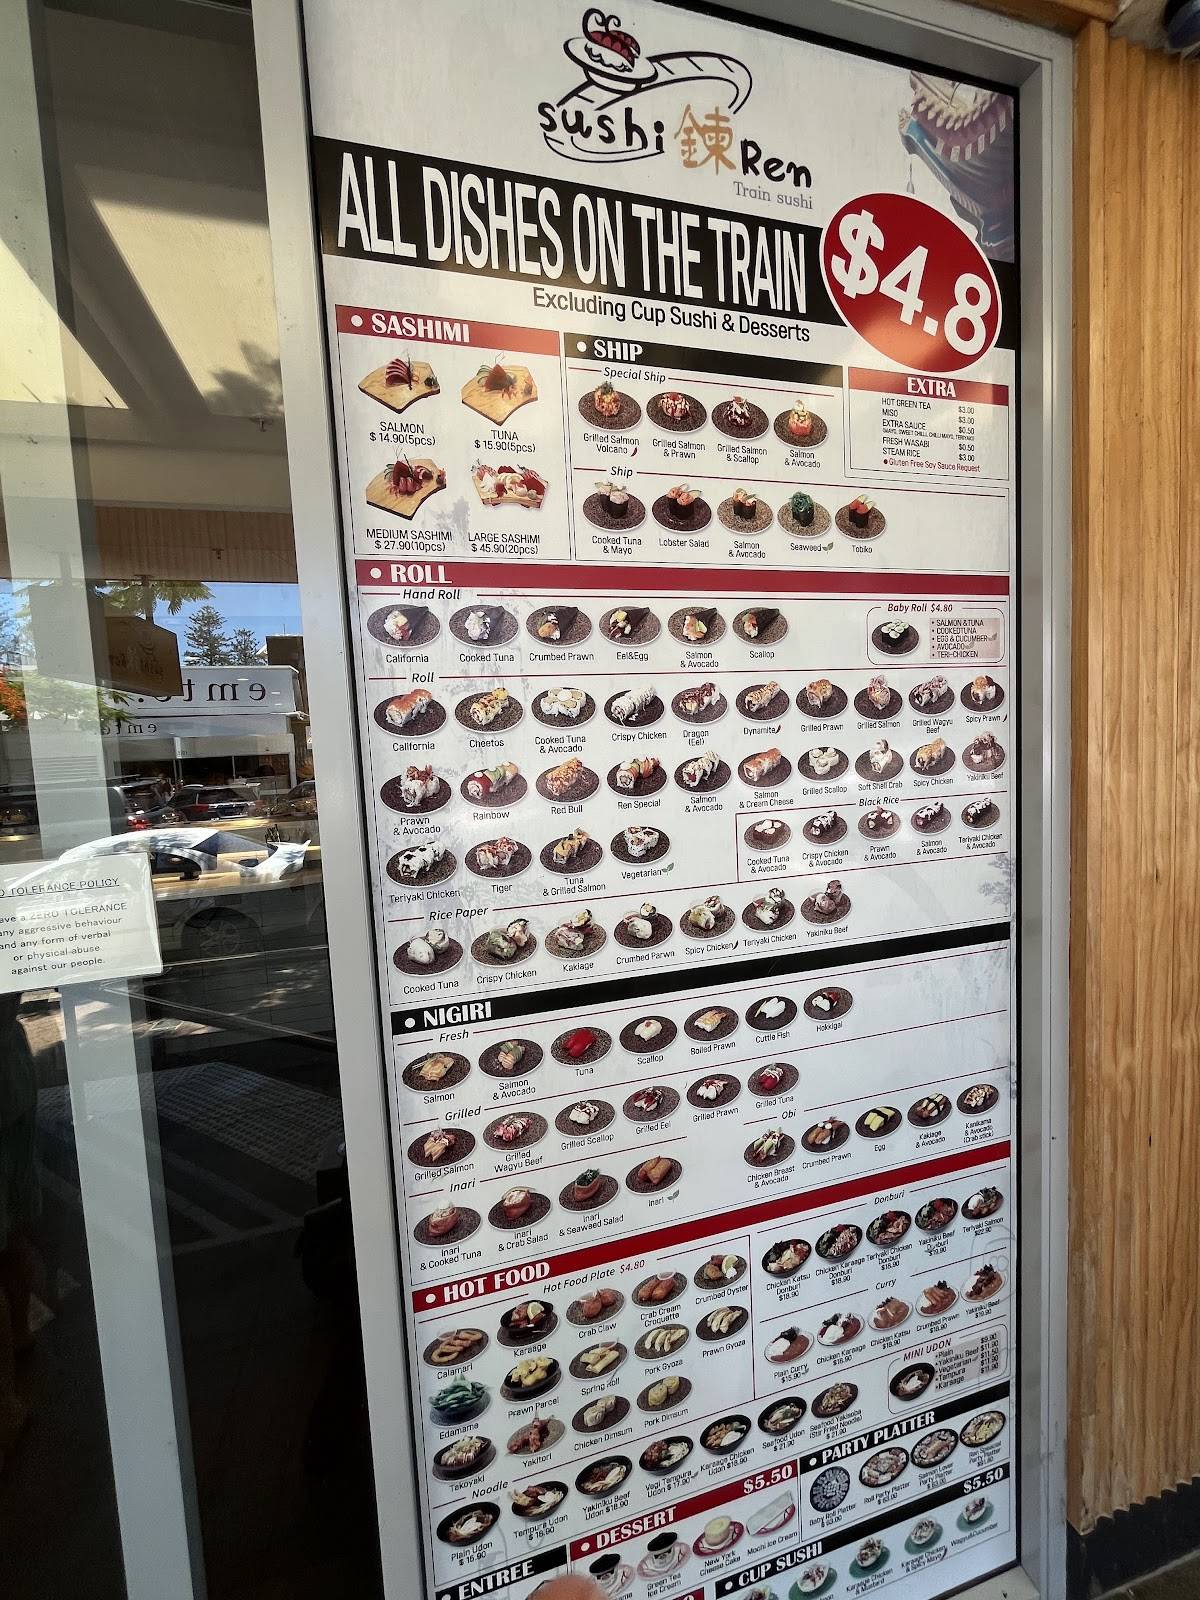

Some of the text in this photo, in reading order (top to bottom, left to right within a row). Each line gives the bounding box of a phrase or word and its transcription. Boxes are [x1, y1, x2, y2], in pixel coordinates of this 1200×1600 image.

[538, 102, 664, 152] sushi
[740, 139, 811, 187] Ren
[733, 182, 812, 210] Train sushi
[337, 152, 806, 314] ALL DISHES ON THE TRAIN
[831, 209, 991, 355] $4.8
[533, 287, 810, 343] Excluding Cup Sushi & Desserts
[371, 313, 469, 343] SASHIMI
[594, 340, 642, 361] SHIP
[604, 367, 666, 383] Special Ship
[907, 377, 956, 397] EXTRA
[882, 398, 931, 410] HOT GREEN TEA
[958, 406, 974, 414] $3.00
[882, 408, 898, 417] MISO
[883, 419, 926, 430] EXTRA SAUCE
[958, 416, 974, 424] $3.00
[380, 421, 424, 434] SALMON
[370, 432, 436, 446] $ 14.90(5pcs)
[491, 430, 519, 440] TUNA
[583, 433, 640, 446] Grilled Salmon
[474, 440, 536, 453] $ 15.90(5pcs)
[883, 437, 929, 448] FRESH WASABI
[596, 444, 628, 455] Volcano
[883, 447, 920, 458] STEAM RICE
[610, 466, 633, 478] Ship
[366, 529, 452, 541] MEDIUM SASHIMI
[468, 533, 540, 544] LARGE SASHIMI
[592, 535, 642, 546] Cooked Tuna
[375, 540, 446, 552] $ 27.90(10pcs)
[471, 543, 539, 555] $ 45.90(20pcs)
[603, 545, 632, 556] & Mayo
[390, 563, 452, 584] ROLL
[403, 589, 460, 600] Hand Roll
[888, 603, 953, 614] Baby Roll $4.80
[386, 654, 429, 663] California
[459, 653, 514, 663] Cooked Tuna
[529, 652, 594, 662] Crumbed Prawn
[616, 652, 649, 663] Eel&Egg
[412, 672, 434, 683] Roll
[535, 734, 586, 745] Cooked Tuna
[612, 731, 667, 743] Crispy Chicken
[392, 741, 435, 752] California
[469, 739, 505, 749] Cheetos
[539, 744, 583, 754] & Avocado
[618, 799, 661, 809] Ren Special
[859, 796, 899, 807] Black Rice
[473, 811, 509, 821] Rainbow
[551, 805, 583, 815] Red Bull
[400, 816, 430, 826] Prawn
[393, 825, 441, 835] & Avocado
[621, 869, 662, 880] Vegetarian
[79, 877, 119, 889] POLICY
[491, 883, 513, 894] Tiger
[390, 889, 461, 903] Teriyaki Chicken
[0, 916, 16, 924] ave
[65, 903, 127, 915] TOLERANCE
[429, 907, 488, 921] Rice Paper
[18, 922, 71, 935] aggressive
[75, 917, 122, 927] behaviour
[21, 940, 37, 948] any
[68, 934, 78, 942] of
[82, 931, 111, 940] verbal
[27, 950, 68, 960] physical
[11, 964, 47, 975] against
[423, 1001, 492, 1027] NIGIRI
[439, 1030, 469, 1043] Fresh
[575, 1067, 594, 1076] Tuna
[423, 1092, 455, 1104] Salmon
[445, 1107, 481, 1121] Grilled
[781, 1110, 796, 1120] Obi
[414, 1162, 474, 1181] Grilled Salmon
[450, 1179, 476, 1192] Inari
[874, 1191, 905, 1204] Donburi
[444, 1262, 550, 1303] HOT FOOD
[543, 1260, 645, 1294] Hot Food Plate $4.80
[875, 1279, 896, 1290] Curry
[513, 1342, 547, 1358] Karaage
[903, 1340, 951, 1361] MINI UDON
[437, 1363, 473, 1380] Calamari
[508, 1397, 560, 1419] Prawn Parcel
[439, 1422, 479, 1440] Edamame
[822, 1411, 935, 1464] PARTY PLATTER
[472, 1480, 508, 1499] Noodle
[596, 1464, 793, 1549] DESSERT $5.50
[738, 1468, 1003, 1588] CUP SUSHI $5.50
[458, 1560, 534, 1600] ENTREE
